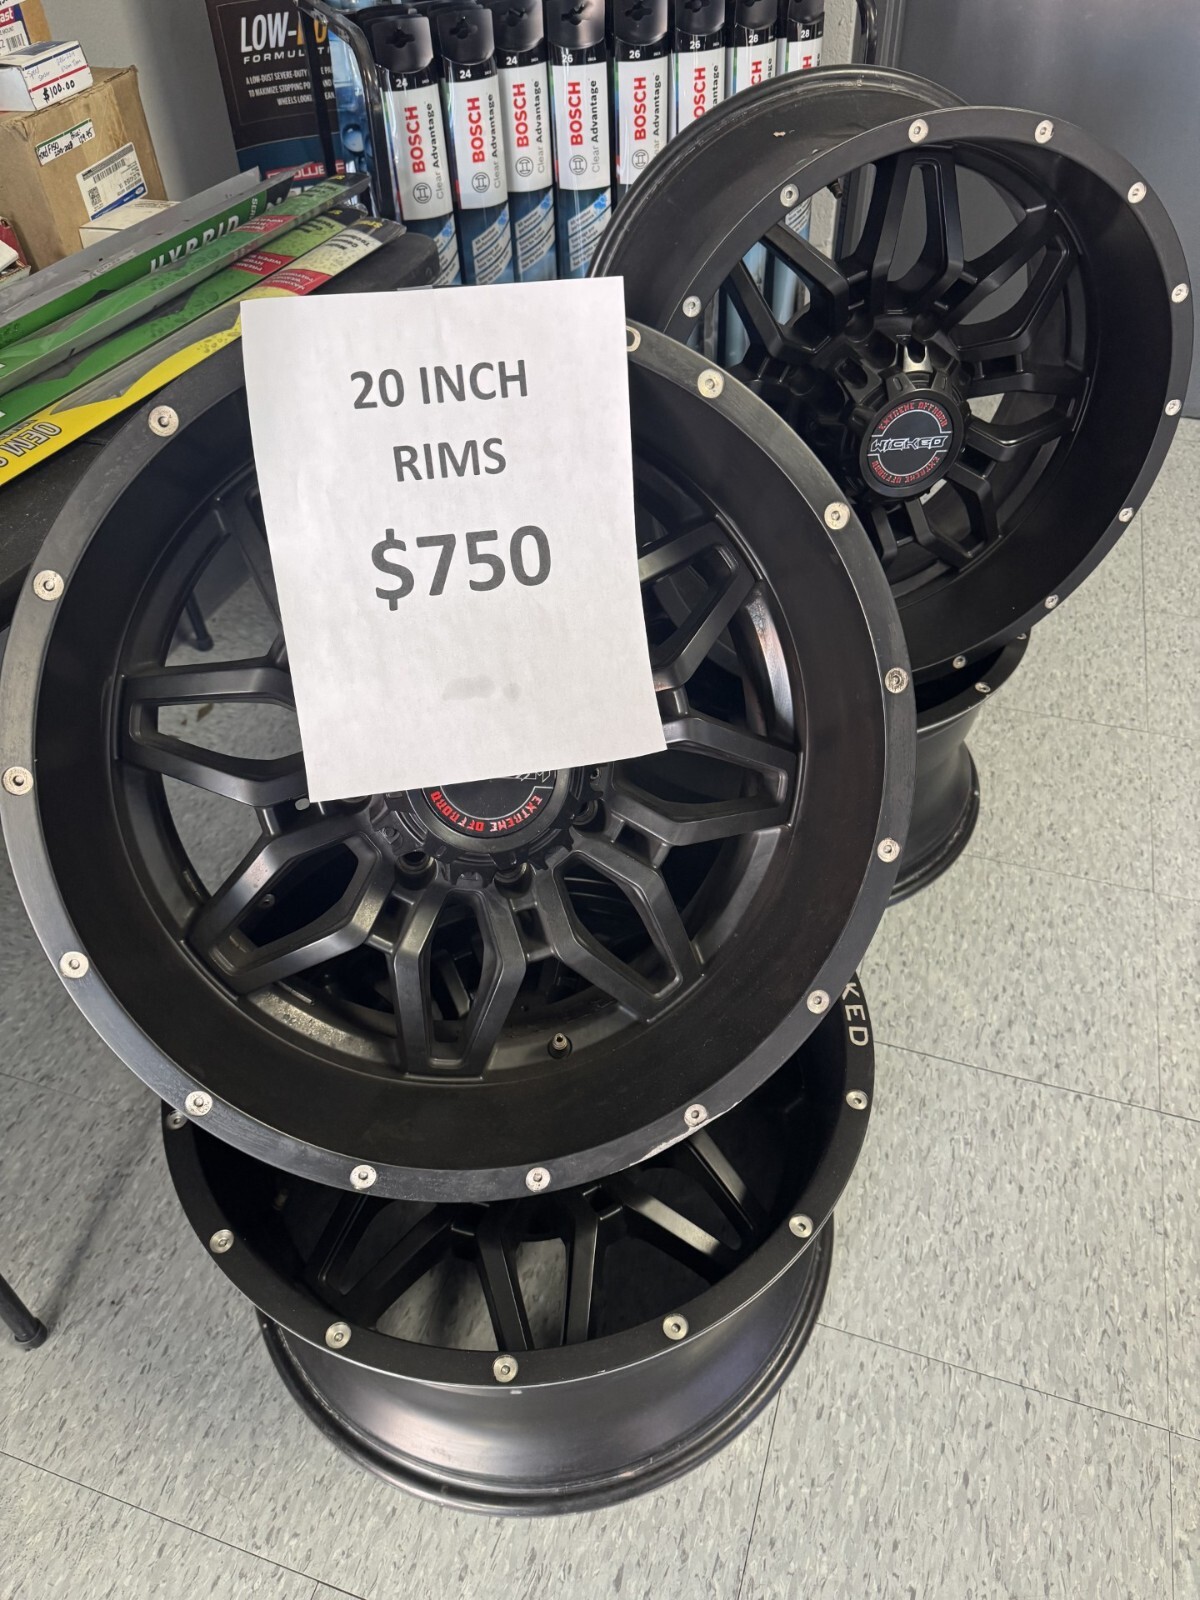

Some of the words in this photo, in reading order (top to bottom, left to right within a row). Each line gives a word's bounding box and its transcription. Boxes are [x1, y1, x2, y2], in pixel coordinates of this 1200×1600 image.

[689, 40, 701, 49] 26
[801, 29, 810, 38] 28
[505, 55, 518, 66] 24
[562, 54, 574, 64] 26
[629, 49, 641, 59] 26
[42, 79, 75, 103] $100.00
[248, 89, 256, 98] TO
[255, 85, 279, 97] MAXIMIZE
[279, 82, 304, 93] STOPPING
[250, 72, 274, 84] LOW-DUST
[274, 68, 308, 80] SEVERE-DUTY
[395, 77, 408, 88] 24
[459, 69, 472, 80] 24
[693, 67, 706, 119] OSCH
[712, 65, 720, 105] antage
[276, 96, 298, 106] WHEELS
[512, 83, 529, 148] BOSCH
[534, 80, 543, 143] Advantage
[568, 81, 583, 146] BOSCH
[590, 80, 599, 143] Advantage
[633, 76, 647, 141] BOSCH
[653, 74, 661, 136] Advantage
[404, 106, 426, 174] BOSCH
[426, 103, 440, 168] Advantage
[467, 97, 485, 164] BOSCH
[488, 94, 498, 158] Advantage
[537, 146, 545, 173] Clear
[591, 145, 600, 173] Clear
[435, 171, 444, 200] Clear
[350, 369, 406, 410] 20
[419, 359, 529, 406] INCH
[0, 421, 62, 458] OEM
[870, 435, 949, 454] WICKED
[393, 437, 507, 483] RIMS
[371, 525, 552, 612] $750
[430, 790, 486, 833] OFFROAD
[489, 795, 543, 833] EXTREME
[841, 982, 869, 1047] KED
